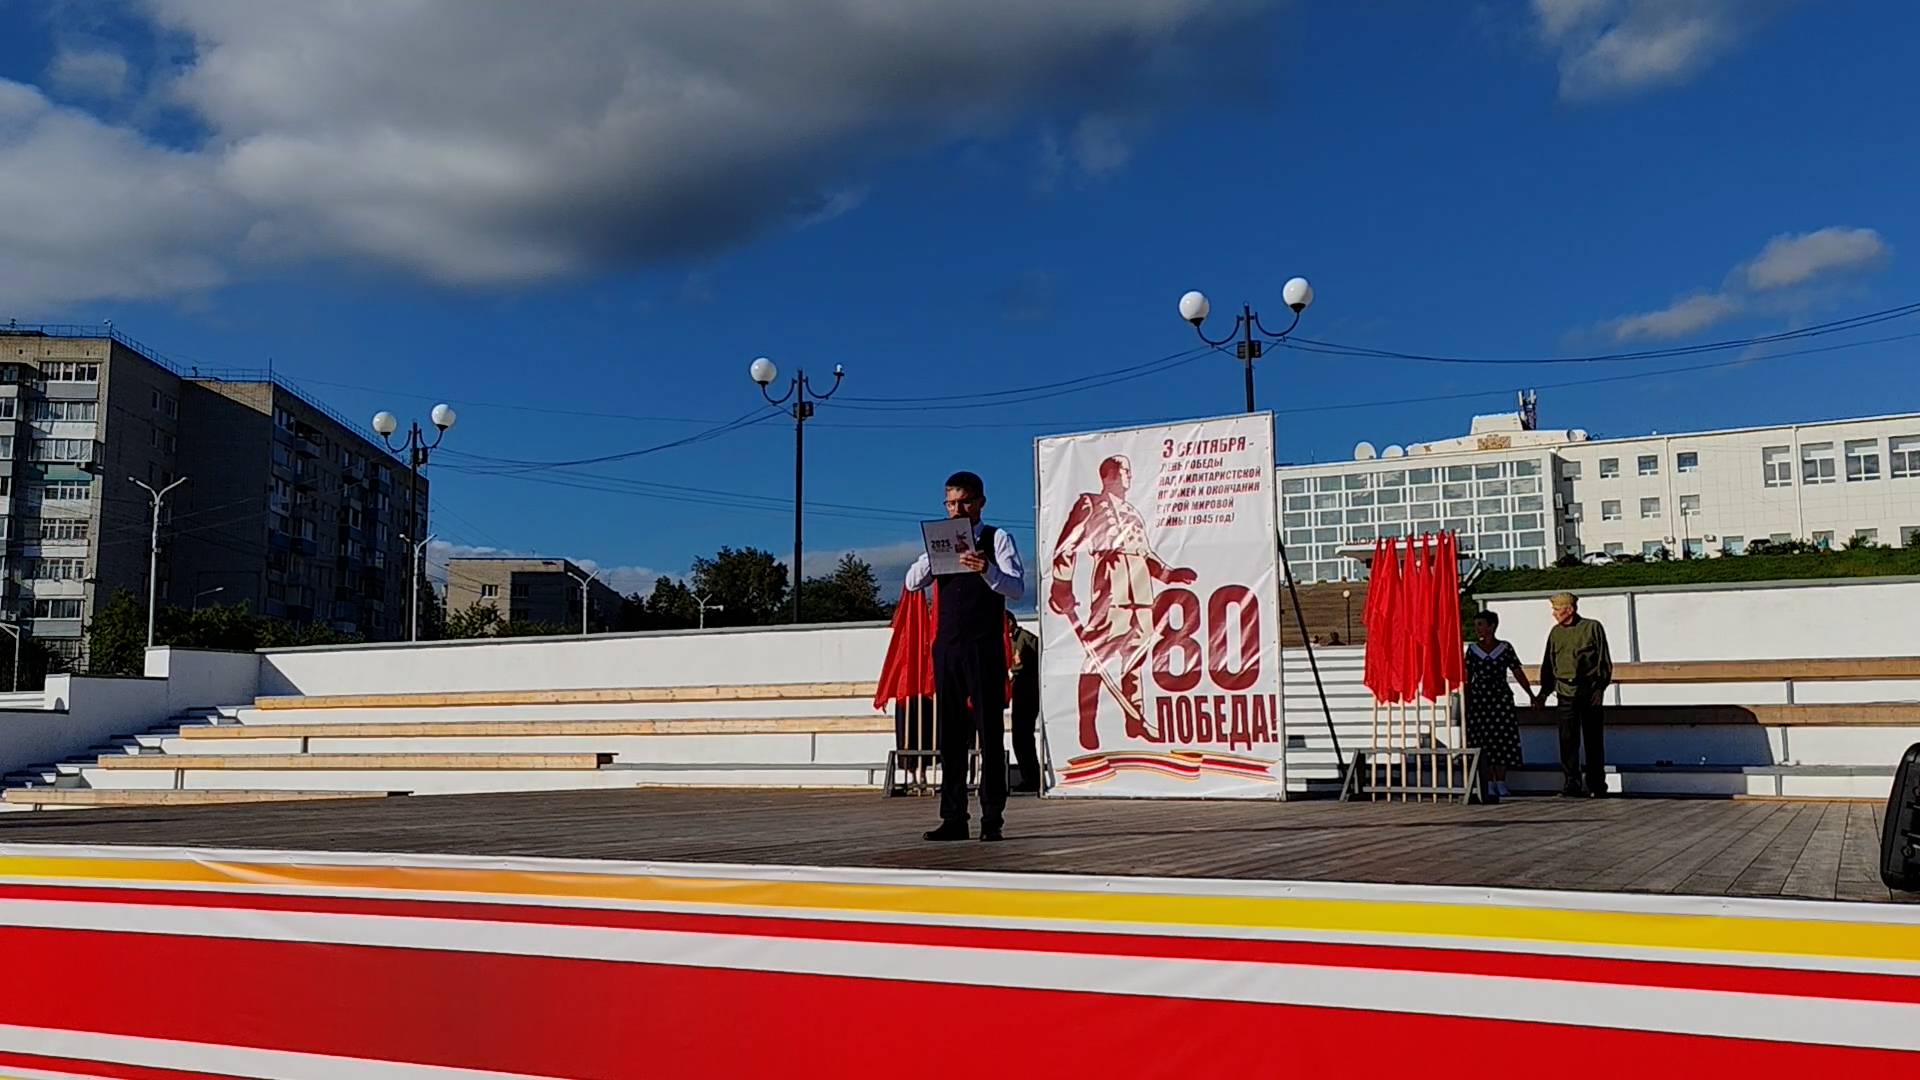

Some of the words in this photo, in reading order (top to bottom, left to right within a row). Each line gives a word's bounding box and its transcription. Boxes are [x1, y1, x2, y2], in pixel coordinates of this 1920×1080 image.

[1163, 439, 1174, 458] 3
[1152, 585, 1259, 692] 80
[1155, 694, 1279, 751] ПОБЕДА!
